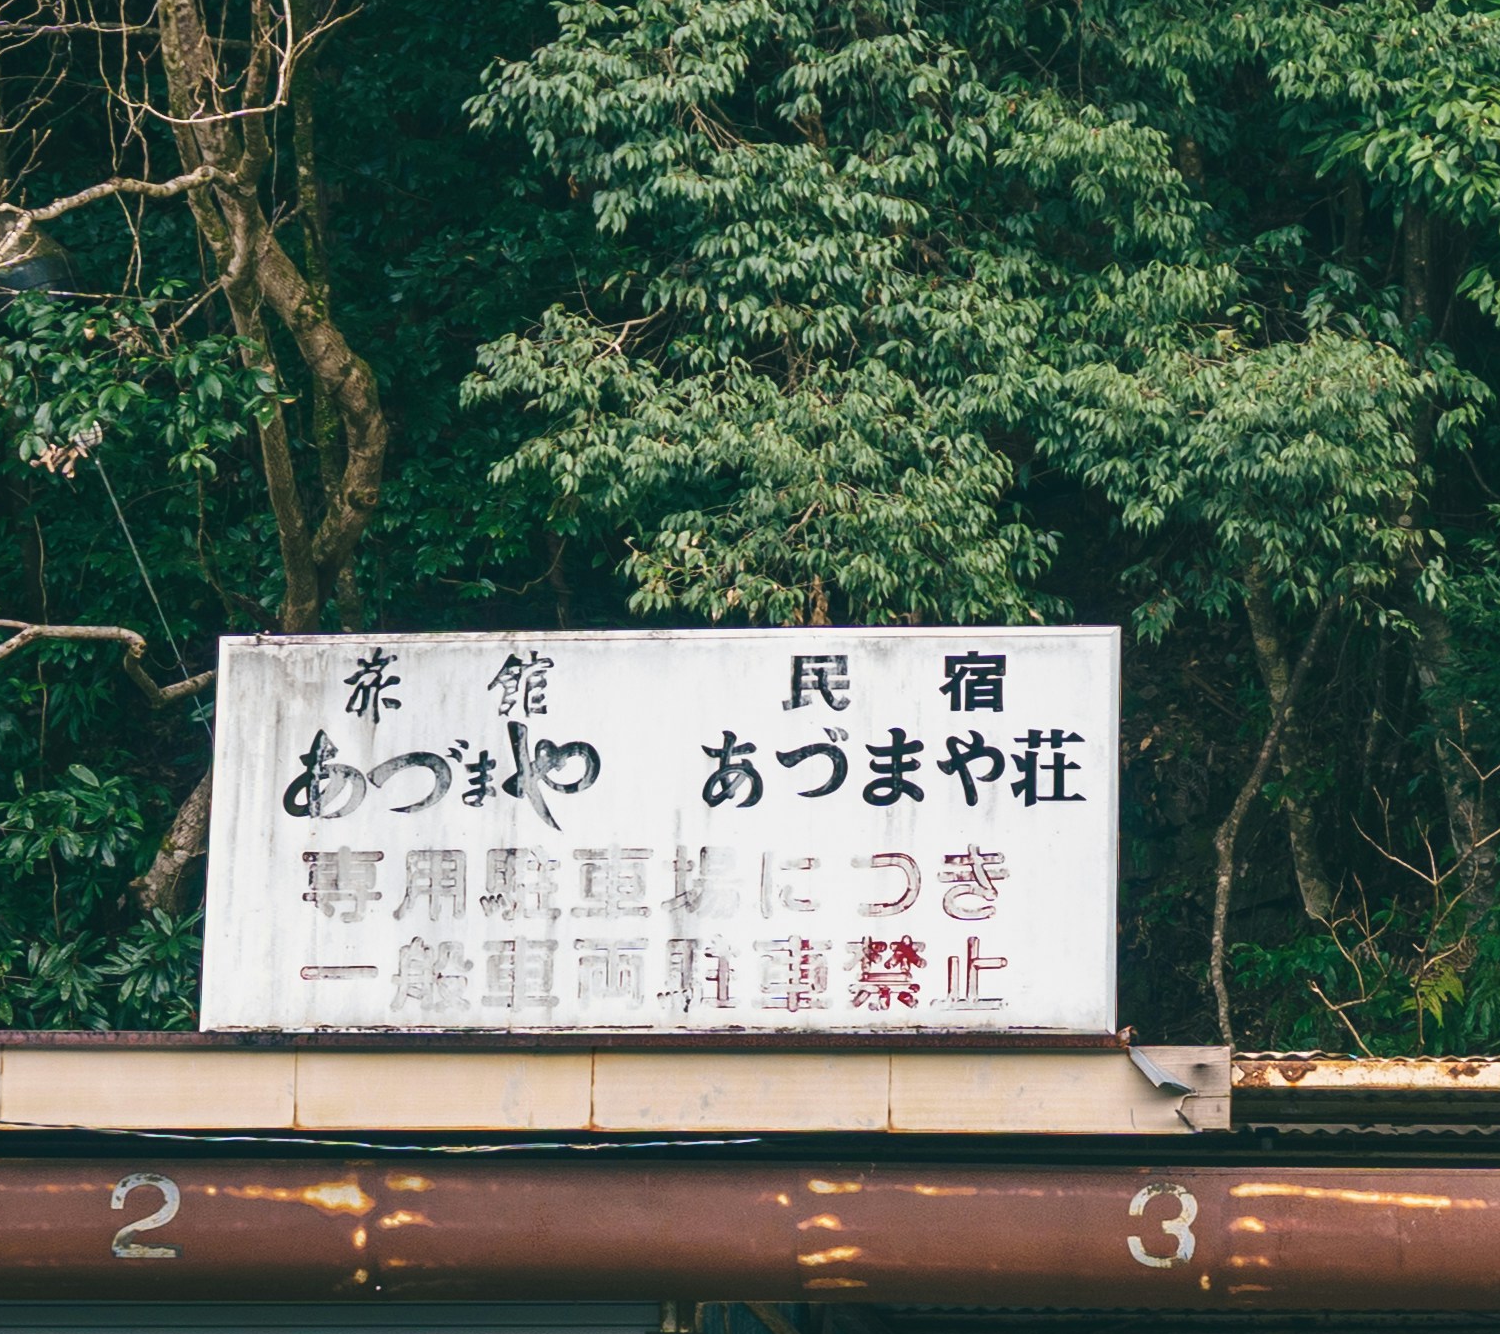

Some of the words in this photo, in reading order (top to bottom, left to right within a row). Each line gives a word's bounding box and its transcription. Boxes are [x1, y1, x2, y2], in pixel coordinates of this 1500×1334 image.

[781, 650, 1007, 713] 民宿
[282, 720, 602, 832] あづまや
[700, 726, 1088, 809] あづまや荘
[301, 843, 1011, 922] 専用駐車場につき
[299, 934, 1009, 1013] 一般車両駐車禁止
[110, 1172, 182, 1259] 2
[1126, 1182, 1199, 1268] 3
